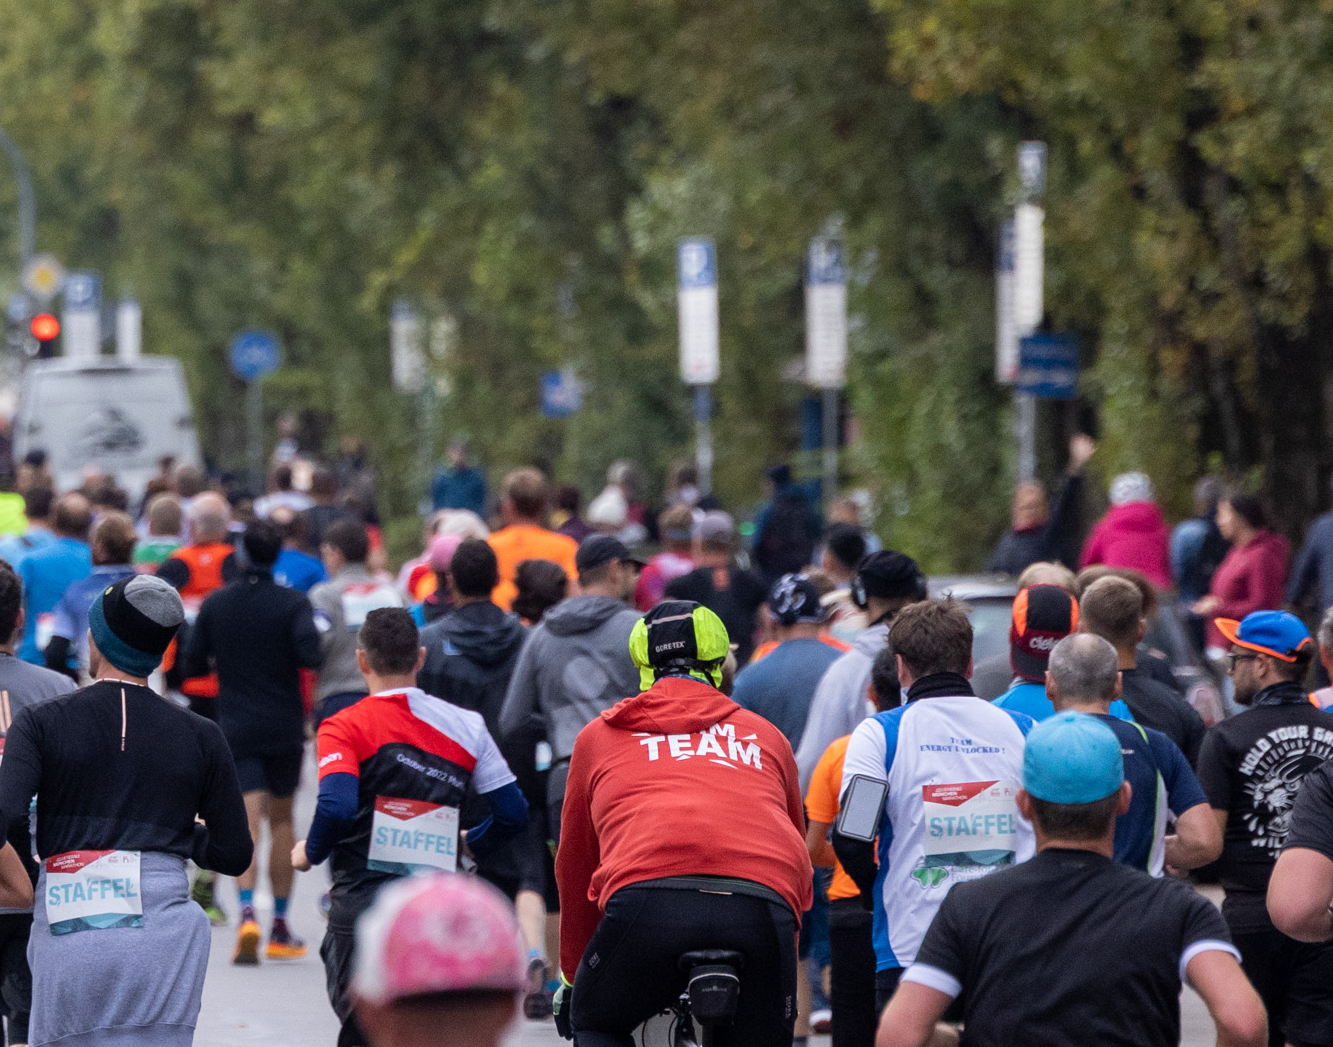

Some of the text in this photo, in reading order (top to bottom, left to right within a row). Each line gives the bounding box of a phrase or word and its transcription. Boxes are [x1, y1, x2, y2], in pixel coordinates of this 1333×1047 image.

[655, 641, 686, 653] GORE-TEX
[639, 733, 763, 770] TEAM
[920, 745, 952, 753] ENERGY
[1238, 737, 1273, 776] HOLD
[1267, 724, 1309, 744] YOUR
[930, 813, 1017, 839] STAFFEL
[375, 826, 456, 857] STAFFEL
[48, 877, 138, 907] STAFFEL
